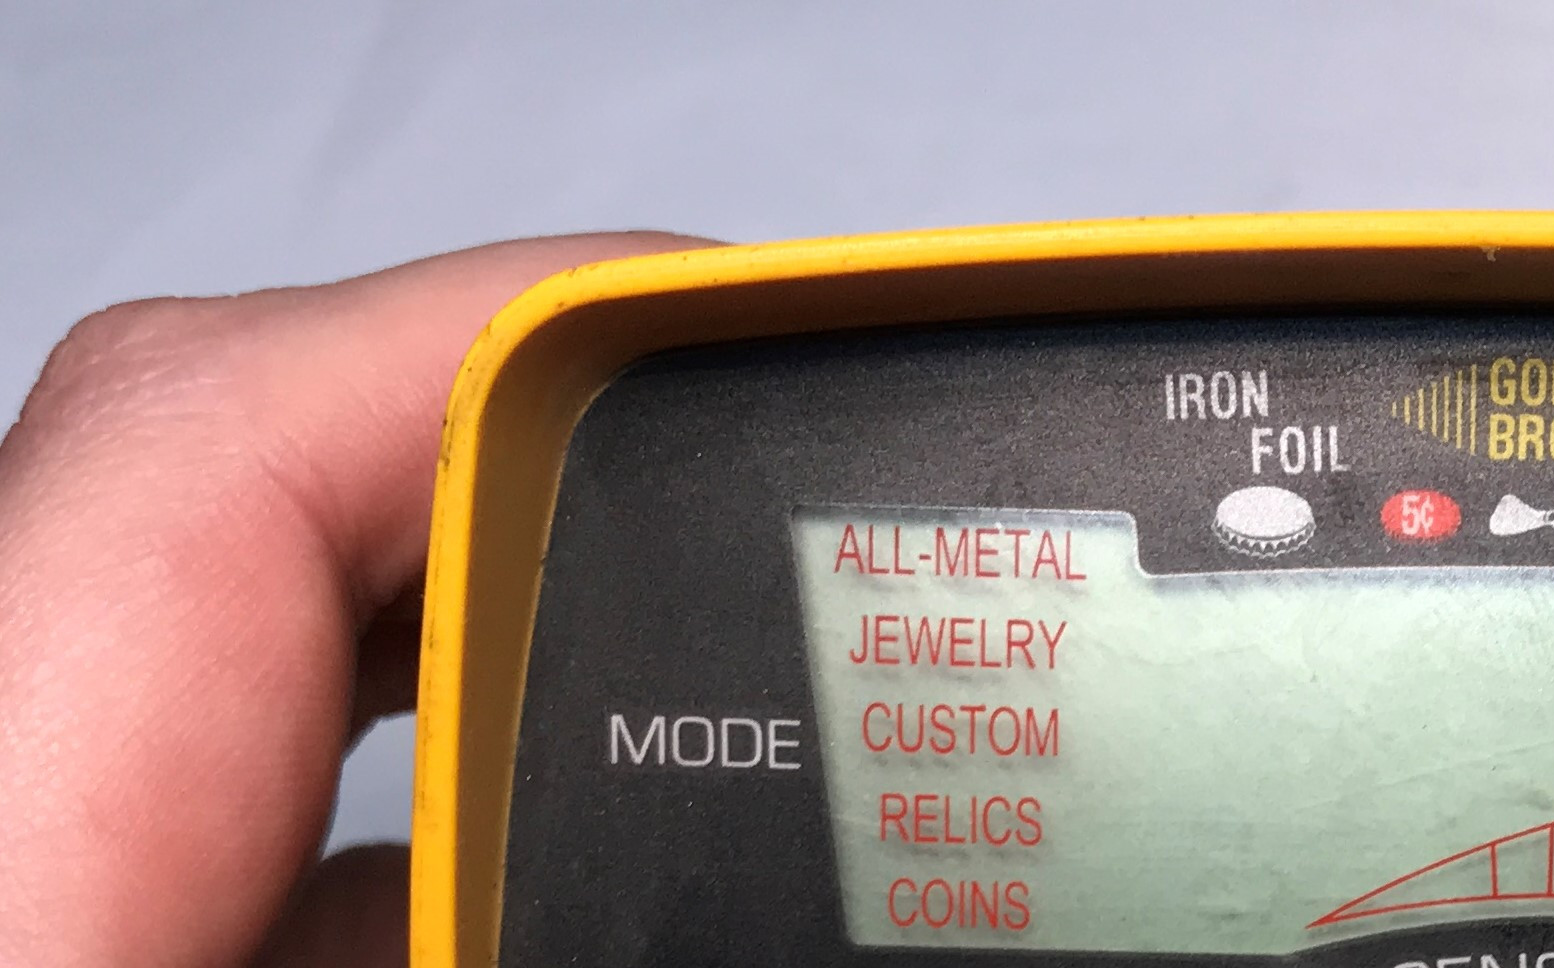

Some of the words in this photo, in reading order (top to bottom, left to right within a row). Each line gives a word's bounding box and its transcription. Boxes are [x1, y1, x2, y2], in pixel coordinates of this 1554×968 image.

[1164, 369, 1269, 420] IRON
[1251, 425, 1350, 475] FOIL
[834, 524, 1087, 581] ALL-METAL
[848, 614, 1069, 671] JEWELRY
[609, 714, 802, 770] MODE
[862, 702, 1060, 756] CUSTOM
[878, 793, 1043, 847] RELICS
[887, 878, 1031, 931] COINS
